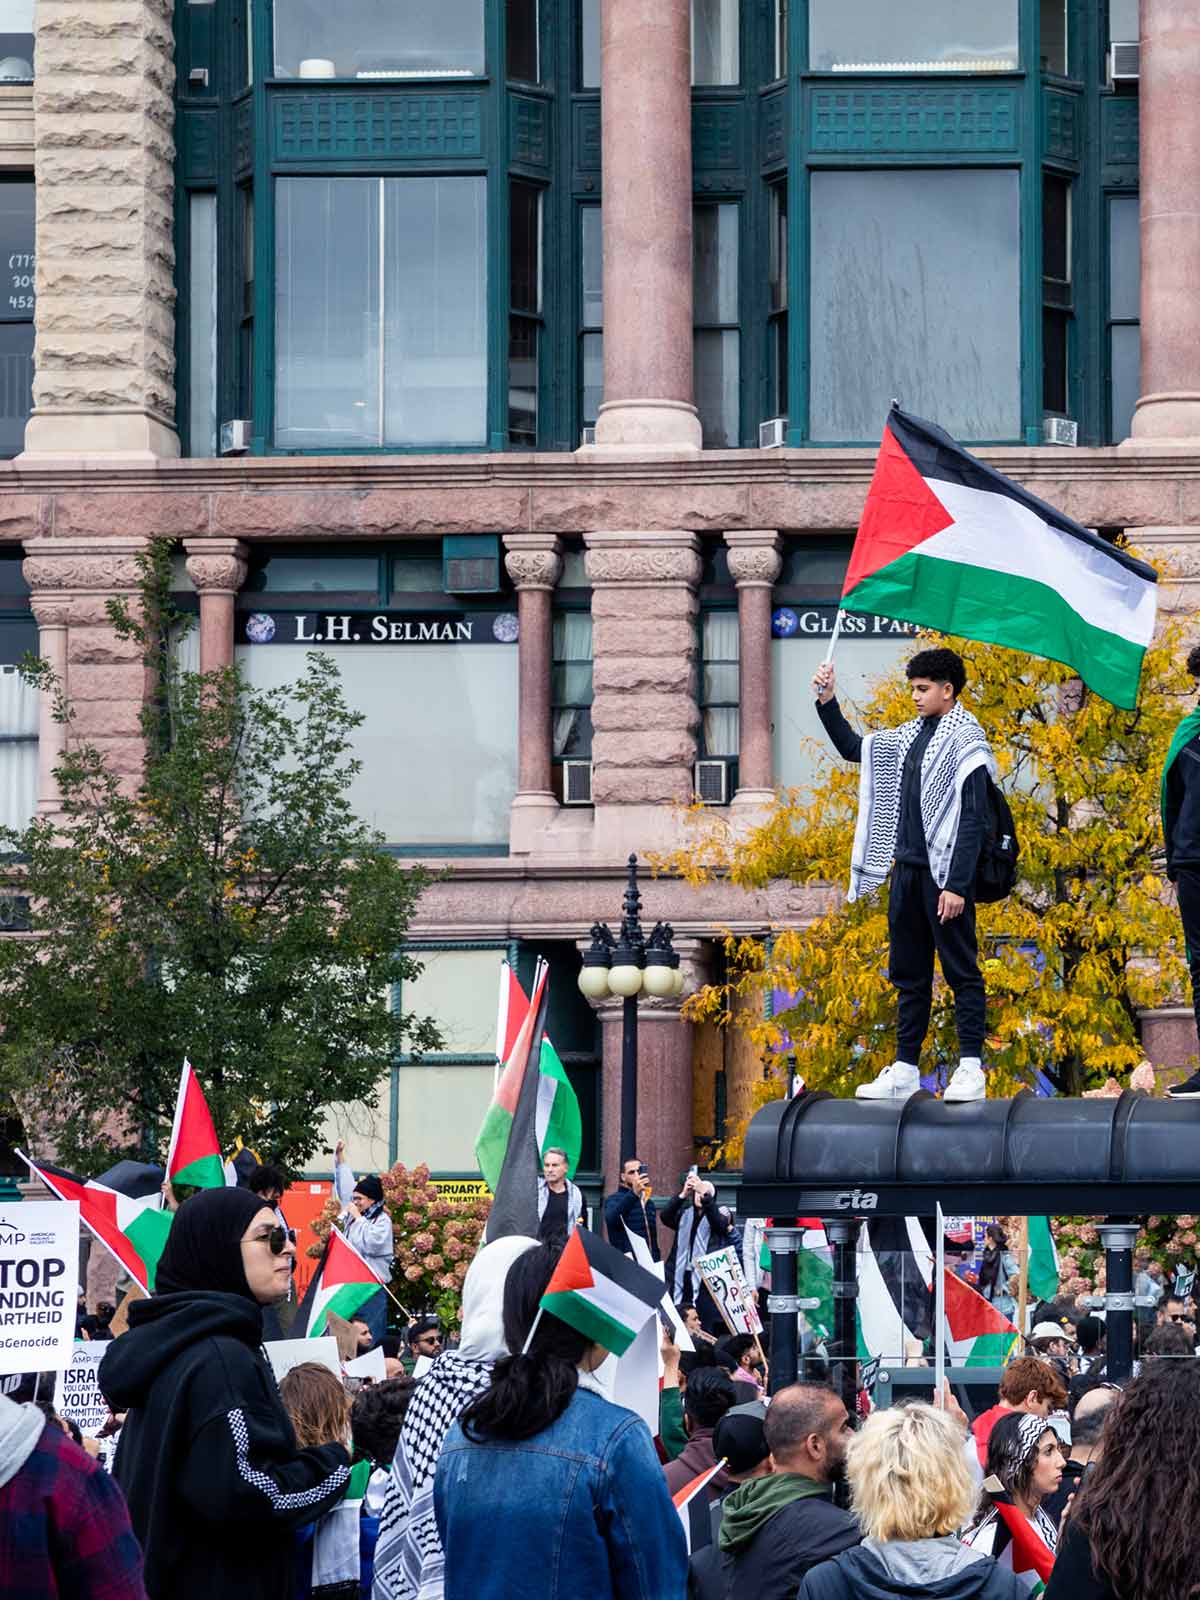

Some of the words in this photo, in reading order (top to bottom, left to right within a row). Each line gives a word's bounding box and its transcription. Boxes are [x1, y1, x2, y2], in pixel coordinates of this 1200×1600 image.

[294, 615, 361, 641] L.H.
[436, 1184, 482, 1194] BRUARY
[0, 1311, 62, 1326] RTHEID
[64, 1369, 96, 1384] ISRA
[64, 1385, 77, 1393] YOU
[63, 1392, 102, 1407] YOU'R
